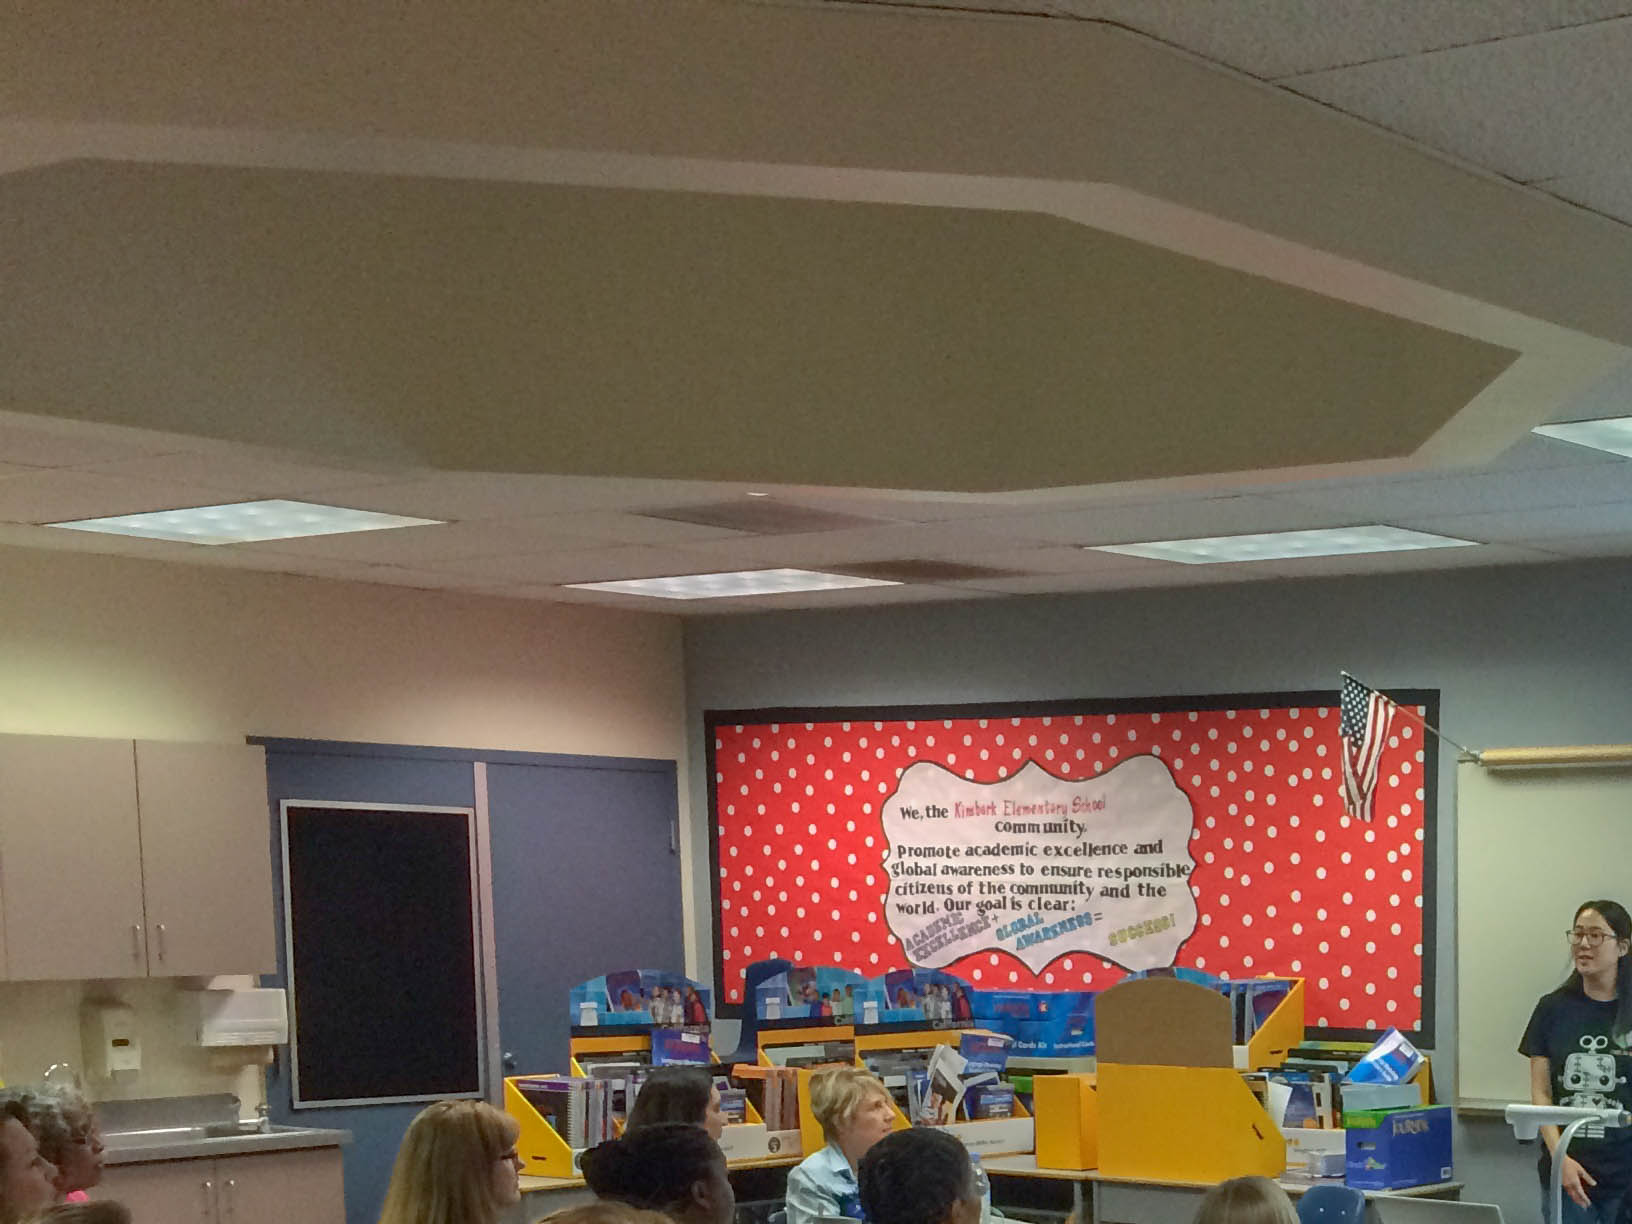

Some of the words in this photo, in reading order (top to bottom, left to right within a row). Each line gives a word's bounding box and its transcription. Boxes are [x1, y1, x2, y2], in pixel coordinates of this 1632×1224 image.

[925, 804, 949, 818] the
[1004, 799, 1068, 816] Elementary
[1072, 795, 1106, 814] School
[965, 842, 1037, 857] academic
[1043, 842, 1128, 857] excellence
[1134, 839, 1163, 855] and
[891, 861, 937, 877] global
[941, 864, 1015, 876] awareness
[1019, 862, 1034, 876] to
[1041, 865, 1092, 878] ensure
[1098, 863, 1190, 881] responsible
[895, 881, 953, 895] citizens
[957, 881, 973, 895] of
[979, 881, 1005, 895] the
[1009, 881, 1094, 902] community
[1100, 884, 1130, 898] and
[1137, 882, 1167, 897] the
[896, 901, 939, 915] world.
[944, 898, 971, 911] Our
[976, 896, 1006, 917] goal
[1011, 897, 1022, 910] is
[1028, 897, 1075, 911] clear:
